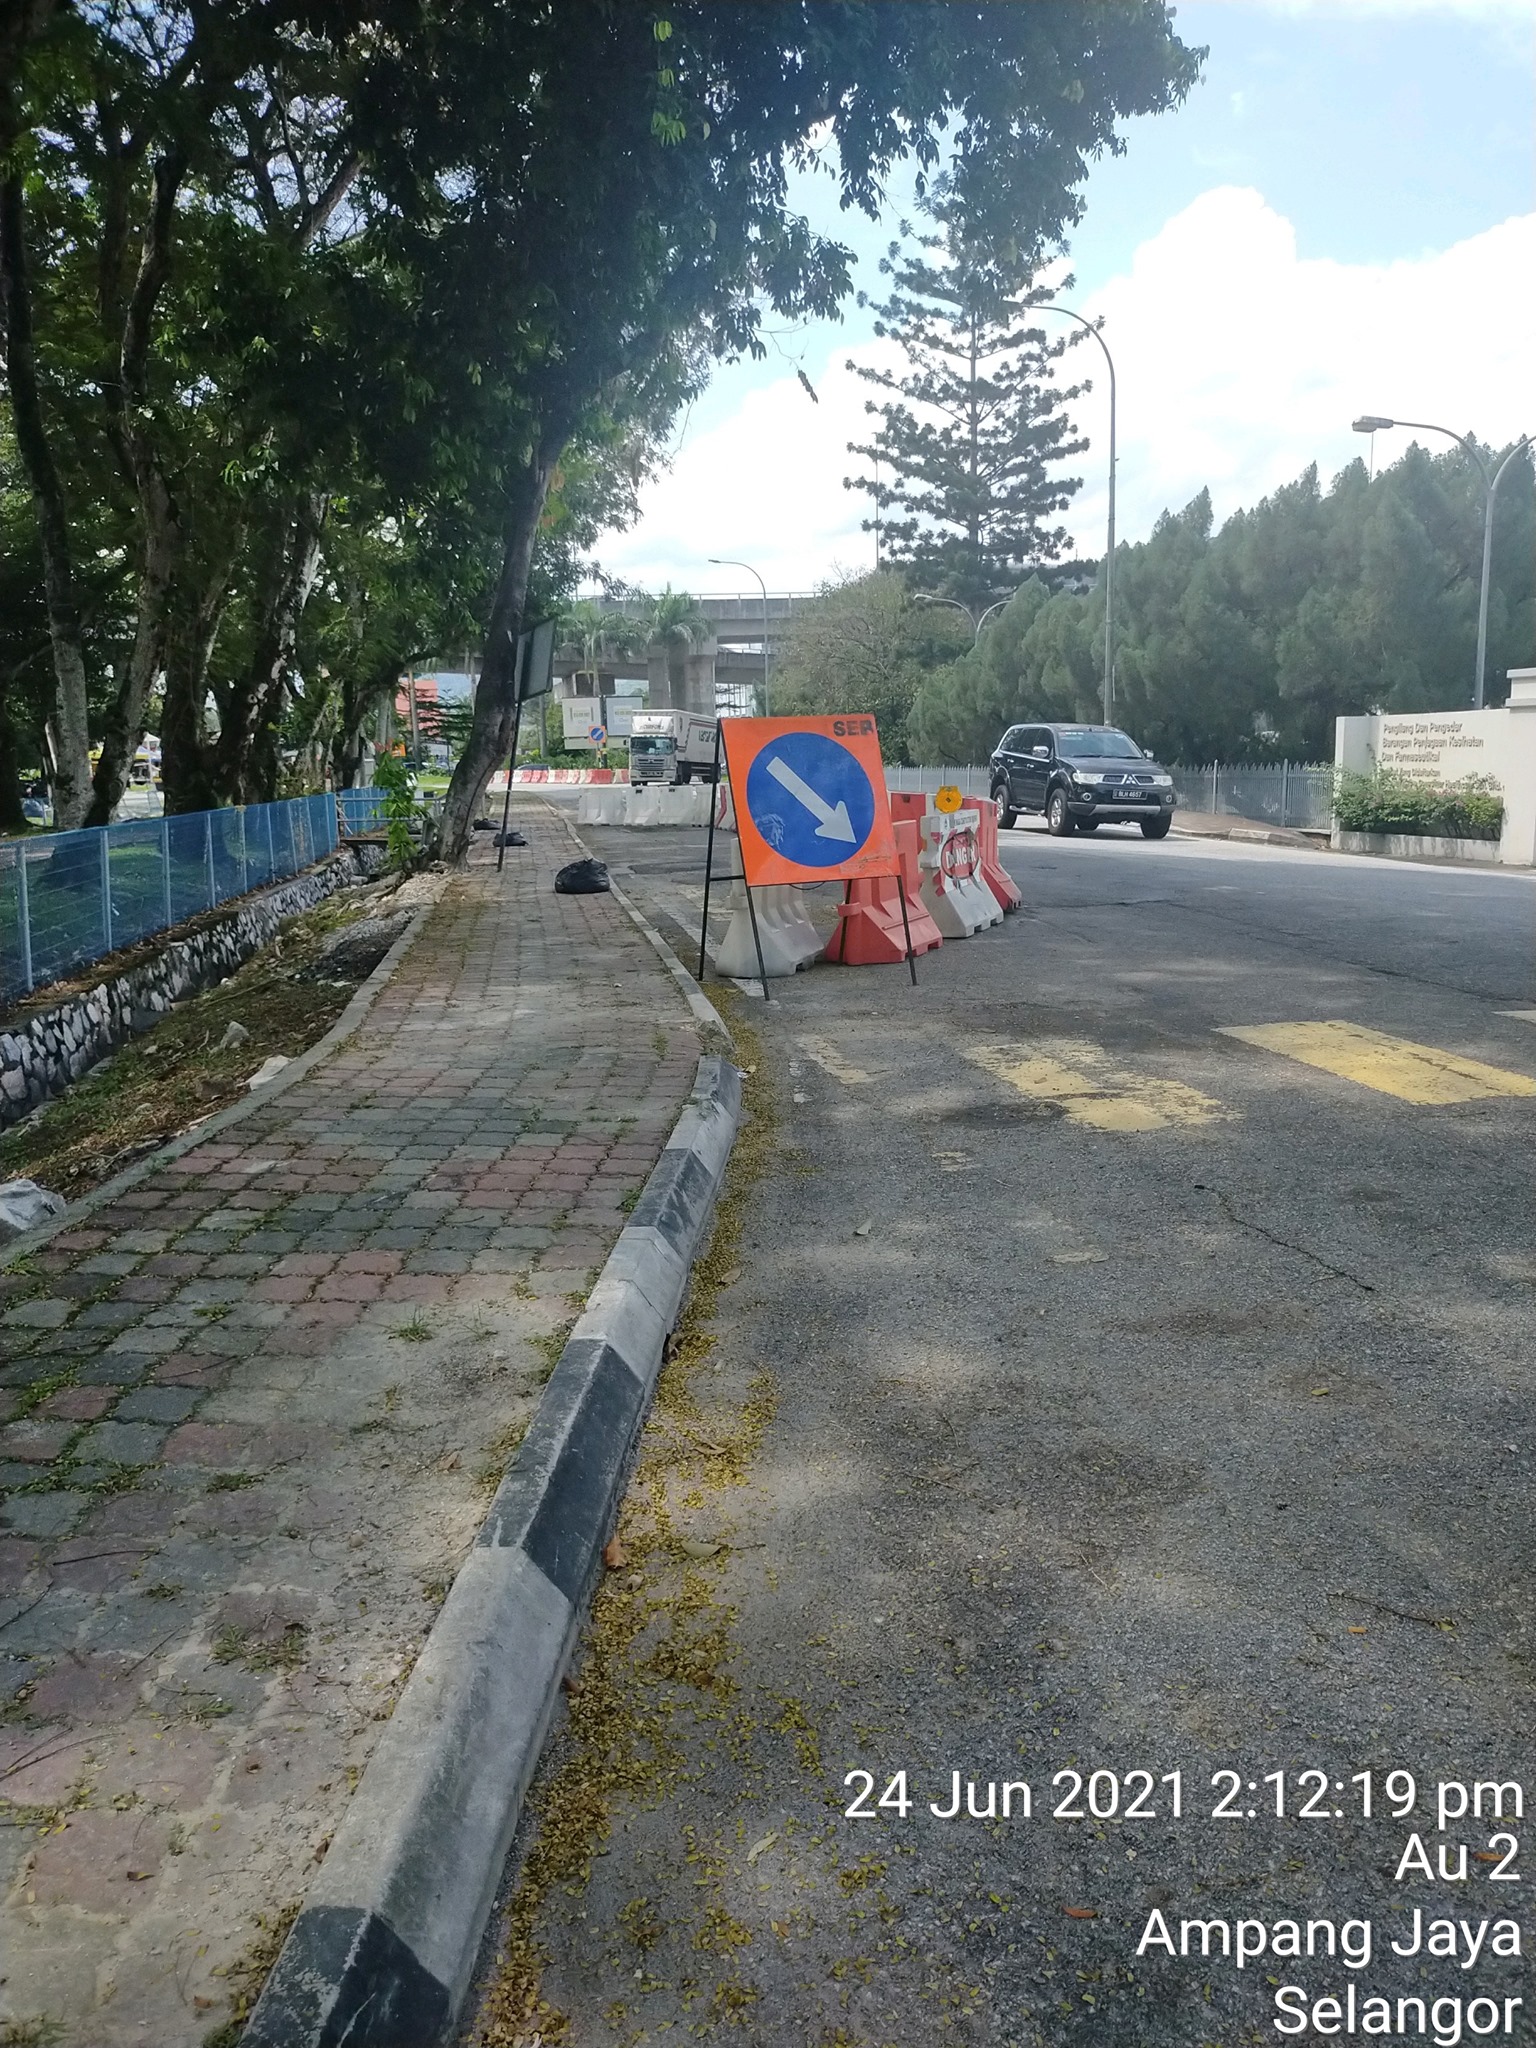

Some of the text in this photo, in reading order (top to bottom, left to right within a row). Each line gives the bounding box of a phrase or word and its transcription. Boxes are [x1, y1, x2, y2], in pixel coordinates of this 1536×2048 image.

[1415, 723, 1428, 733] Dan
[1430, 721, 1463, 734] Pengedar
[1382, 736, 1484, 749] Barangan Penjagaan Kesihatan
[1381, 751, 1394, 762] Dan
